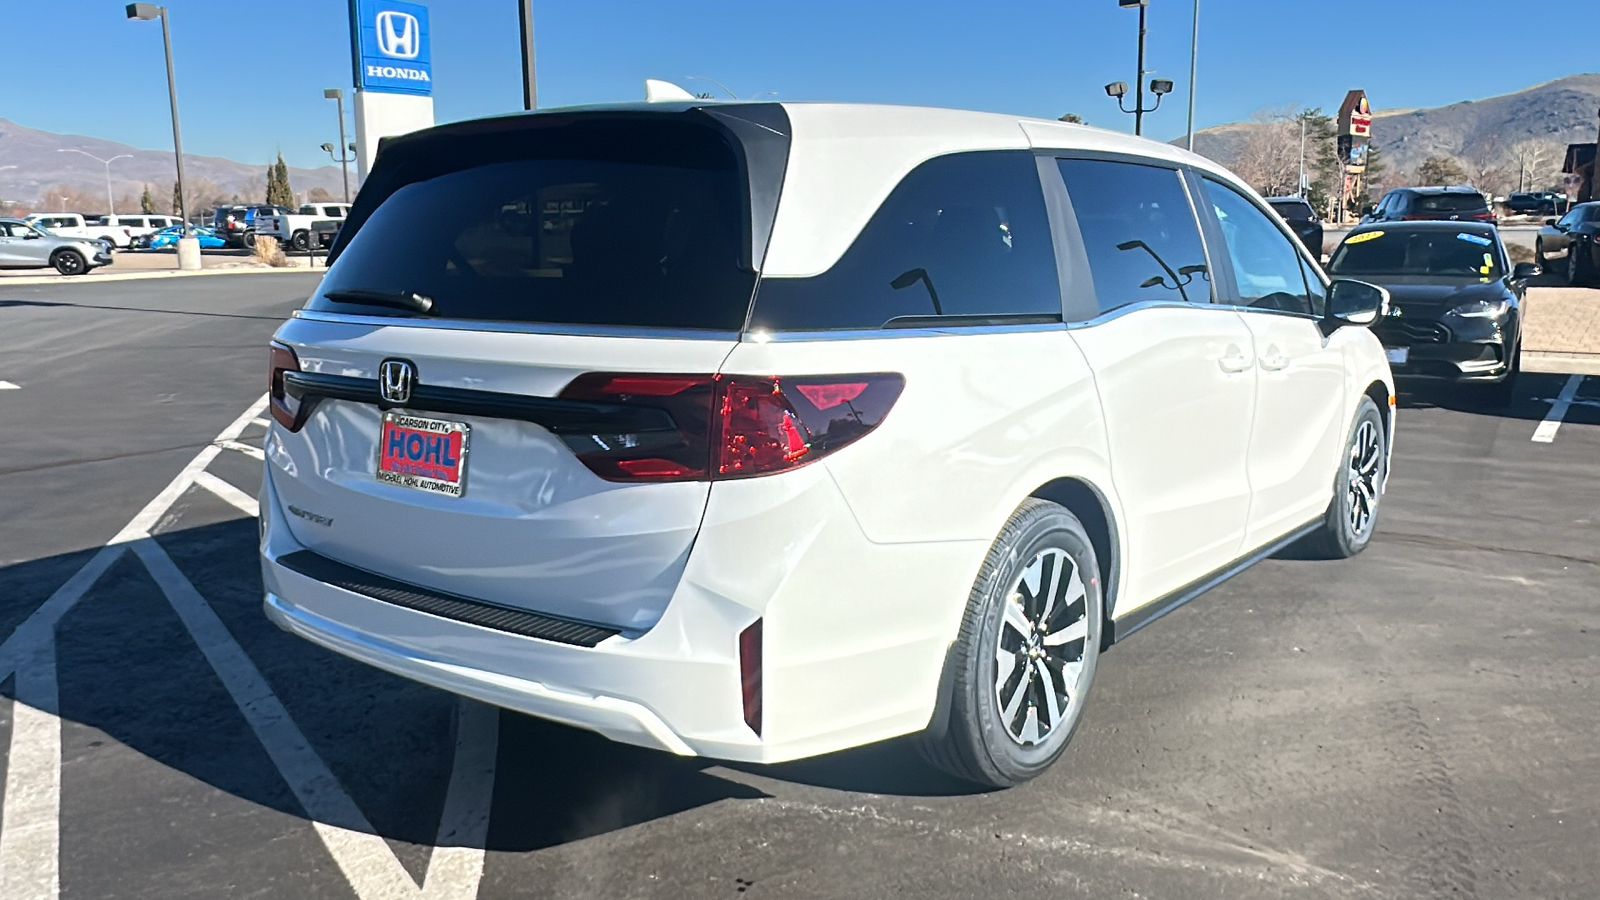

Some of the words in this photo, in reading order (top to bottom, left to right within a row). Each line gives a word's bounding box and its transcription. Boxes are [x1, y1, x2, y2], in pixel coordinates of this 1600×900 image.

[367, 65, 430, 81] HONDA
[399, 417, 429, 430] CARSON
[430, 421, 447, 432] CITY
[388, 429, 456, 466] HOHL
[404, 477, 419, 489] HOHL
[420, 480, 460, 495] AUTOMOTIVE
